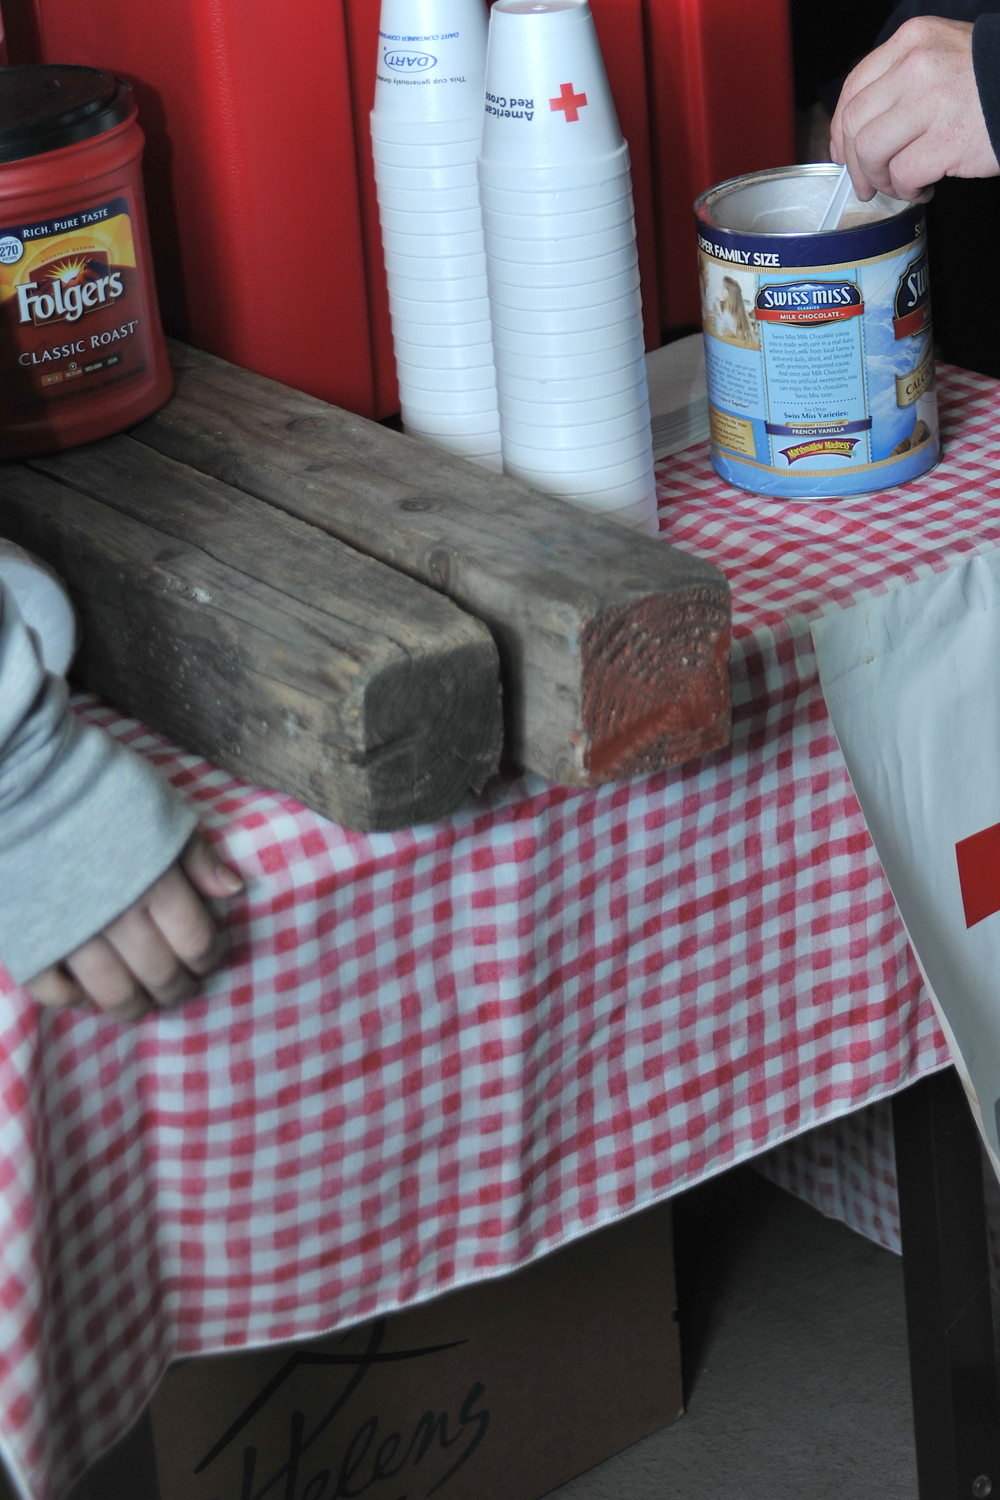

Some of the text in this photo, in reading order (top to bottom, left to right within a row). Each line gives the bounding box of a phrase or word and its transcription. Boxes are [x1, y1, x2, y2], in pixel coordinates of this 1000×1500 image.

[402, 33, 439, 41] CONTAINER
[441, 32, 459, 40] DART
[389, 56, 429, 66] DART
[393, 78, 430, 86] generously
[486, 92, 534, 109] Red Cross
[485, 104, 534, 121] American
[54, 218, 79, 231] PURE
[81, 208, 109, 224] TASTE
[714, 244, 751, 264] FAMILY
[753, 253, 780, 266] SIZE
[15, 271, 124, 323] Folgers
[764, 286, 851, 307] SWISS MISS
[798, 311, 839, 319] CHOCOLATE
[19, 322, 135, 366] CLASSIC ROAST
[787, 441, 850, 459] Marshmallow Madness
